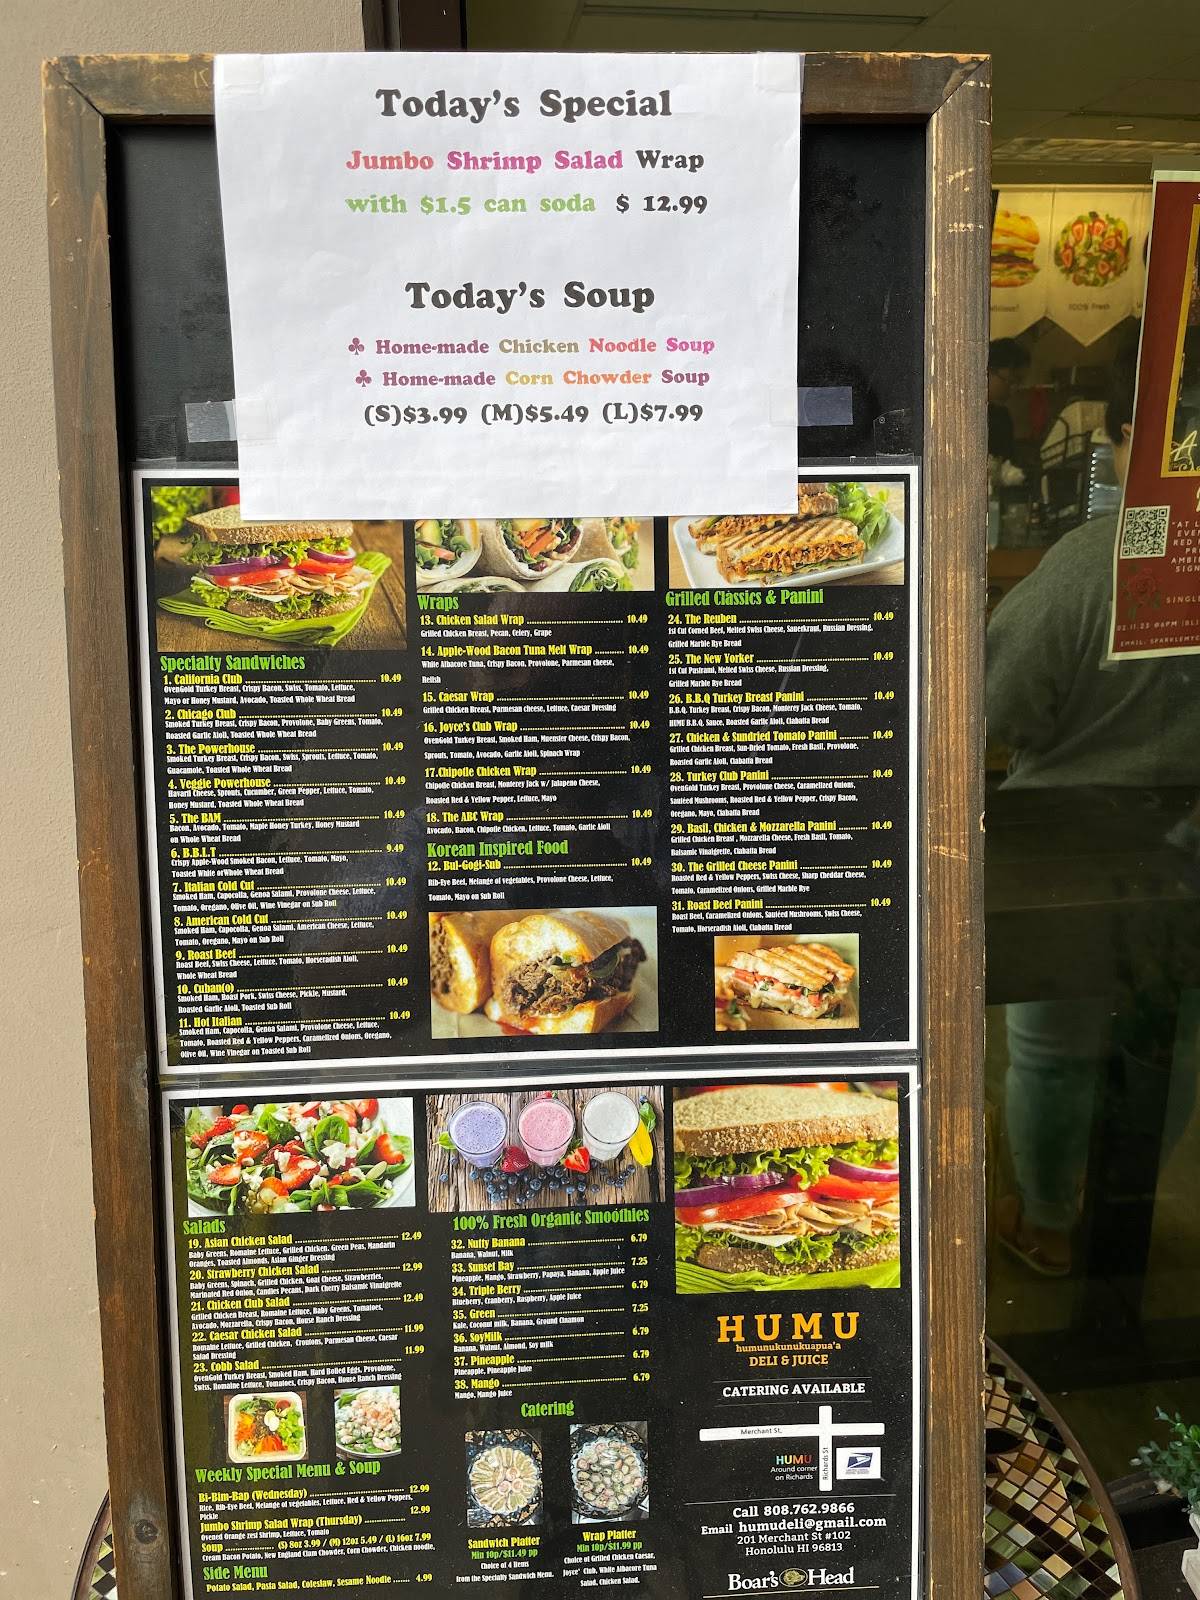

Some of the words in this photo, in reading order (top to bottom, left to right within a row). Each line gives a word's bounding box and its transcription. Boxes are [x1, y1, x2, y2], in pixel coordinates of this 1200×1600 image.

[375, 88, 521, 124] Today's
[540, 88, 673, 124] Special
[345, 150, 435, 170] Jumbo
[447, 150, 542, 173] Shrimp
[554, 150, 624, 170] Salad
[635, 150, 705, 172] Wrap
[345, 194, 408, 213] with
[420, 194, 472, 216] $1.5
[484, 197, 528, 213] can
[540, 194, 597, 213] soda
[616, 193, 630, 214] $
[643, 195, 708, 216] 12.99
[405, 281, 546, 314] Today's
[563, 281, 656, 314] Soup
[375, 338, 490, 355] Home-made
[498, 337, 580, 355] Chicken
[588, 337, 657, 354] Noodle
[665, 336, 715, 356] Soup
[382, 370, 496, 387] Home-made
[505, 369, 554, 387] Corn
[563, 369, 652, 386] Chowder
[661, 368, 710, 389] Soup
[364, 403, 468, 427] (S)$3.99
[481, 403, 590, 426] (M)$5.49
[602, 402, 705, 424] (L)$7.99
[1173, 538, 1193, 546] RED
[417, 594, 459, 611] Wraps
[665, 590, 710, 607] Grilled
[714, 590, 762, 606] Classics
[765, 590, 777, 605] &
[780, 589, 824, 605] Panini
[420, 615, 434, 626] 13.
[436, 615, 472, 625] Chicken
[473, 614, 498, 625] Salad
[500, 614, 525, 627] Wrap
[626, 614, 648, 624] 10.49
[667, 614, 682, 625] 24.
[684, 614, 702, 624] The
[703, 613, 737, 624] Reuben
[873, 611, 895, 621] 10.49
[420, 629, 442, 637] Grilled
[442, 629, 467, 637] Chicken
[467, 628, 490, 637] Breast,
[490, 629, 511, 637] Pecan,
[512, 628, 533, 638] Celery,
[533, 628, 552, 638] Grape
[668, 640, 689, 648] Grilled
[689, 640, 710, 648] Marble
[711, 639, 724, 649] Rye
[724, 639, 742, 647] Bread
[160, 655, 222, 673] Specialty
[225, 654, 306, 670] Sandwiches
[163, 675, 172, 685] 1.
[174, 674, 220, 685] California
[221, 674, 243, 684] Club
[380, 673, 402, 683] 10.49
[164, 697, 181, 706] Mayo
[182, 697, 190, 705] or
[190, 696, 211, 706] Honey
[212, 696, 239, 705] Mustard,
[239, 695, 269, 705] Avocado,
[269, 695, 294, 704] Toasted
[295, 695, 315, 704] Whole
[316, 695, 336, 703] Wheat
[336, 695, 356, 703] Bread
[427, 842, 475, 858] Korean
[479, 840, 533, 858] Inspired
[537, 839, 569, 855] Food
[172, 882, 183, 893] 7.
[184, 881, 216, 893] Italian
[217, 881, 238, 891] Cold
[240, 880, 255, 891] Cut
[385, 877, 407, 887] 10.49
[183, 1219, 226, 1235] Salads
[453, 1216, 490, 1231] 100%
[492, 1214, 528, 1229] Fresh
[531, 1211, 582, 1230] Organic
[584, 1208, 650, 1225] Smoothies
[451, 1264, 466, 1273] 33.
[468, 1262, 496, 1273] Sunset
[497, 1261, 515, 1273] Bay
[631, 1257, 648, 1266] 7.25
[190, 1301, 204, 1312] 21.
[206, 1300, 242, 1311] Chicken
[244, 1298, 264, 1309] Club
[265, 1297, 290, 1308] Salad
[402, 1293, 424, 1303] 12.49
[452, 1297, 484, 1306] Blueberry,
[484, 1295, 516, 1305] Cranberry,
[516, 1294, 549, 1304] Raspberry,
[549, 1293, 566, 1302] Apple
[567, 1292, 582, 1301] Juice
[716, 1311, 860, 1343] HUMU
[735, 1341, 842, 1353] humunukunukuapua'a
[749, 1356, 778, 1367] DELI
[781, 1355, 789, 1366] &
[792, 1353, 829, 1366] JUICE
[722, 1384, 789, 1397] CATERING
[792, 1383, 866, 1395] AVAILABLE
[520, 1400, 575, 1418] Catering
[740, 1428, 772, 1436] Merchant
[776, 1454, 813, 1464] HUMU
[195, 1467, 243, 1483] Weekly
[246, 1465, 293, 1481] Special
[296, 1463, 331, 1478] Menu
[334, 1462, 346, 1476] &
[349, 1460, 381, 1475] Soup
[770, 1465, 796, 1474] Around
[796, 1465, 818, 1473] corner
[785, 1473, 814, 1481] Richards
[732, 1506, 759, 1518] Call
[763, 1502, 855, 1516] 808.762.9866
[701, 1524, 733, 1535] Email
[738, 1516, 887, 1533] humudeli@gmail.com
[467, 1538, 509, 1549] Sandwich
[510, 1536, 541, 1547] Platter
[582, 1530, 606, 1542] Wrap
[607, 1529, 637, 1541] Platter
[736, 1535, 756, 1545] 201
[758, 1533, 809, 1544] Merchant
[811, 1532, 823, 1541] St
[825, 1530, 851, 1540] #102
[745, 1545, 795, 1556] Honolulu
[796, 1544, 809, 1553] HI
[812, 1543, 843, 1552] 96813
[203, 1566, 231, 1581] Side
[233, 1565, 268, 1579] Menu
[728, 1570, 779, 1591] Boar's
[807, 1566, 855, 1586] Head
[206, 1582, 231, 1593] Potato
[231, 1581, 255, 1591] Salad,
[256, 1580, 276, 1591] Pasta
[277, 1579, 300, 1590] Salad,
[301, 1578, 336, 1589] Coleslaw,
[336, 1577, 364, 1587] Sesame
[365, 1575, 392, 1585] Noodle
[415, 1573, 433, 1583] 4.99
